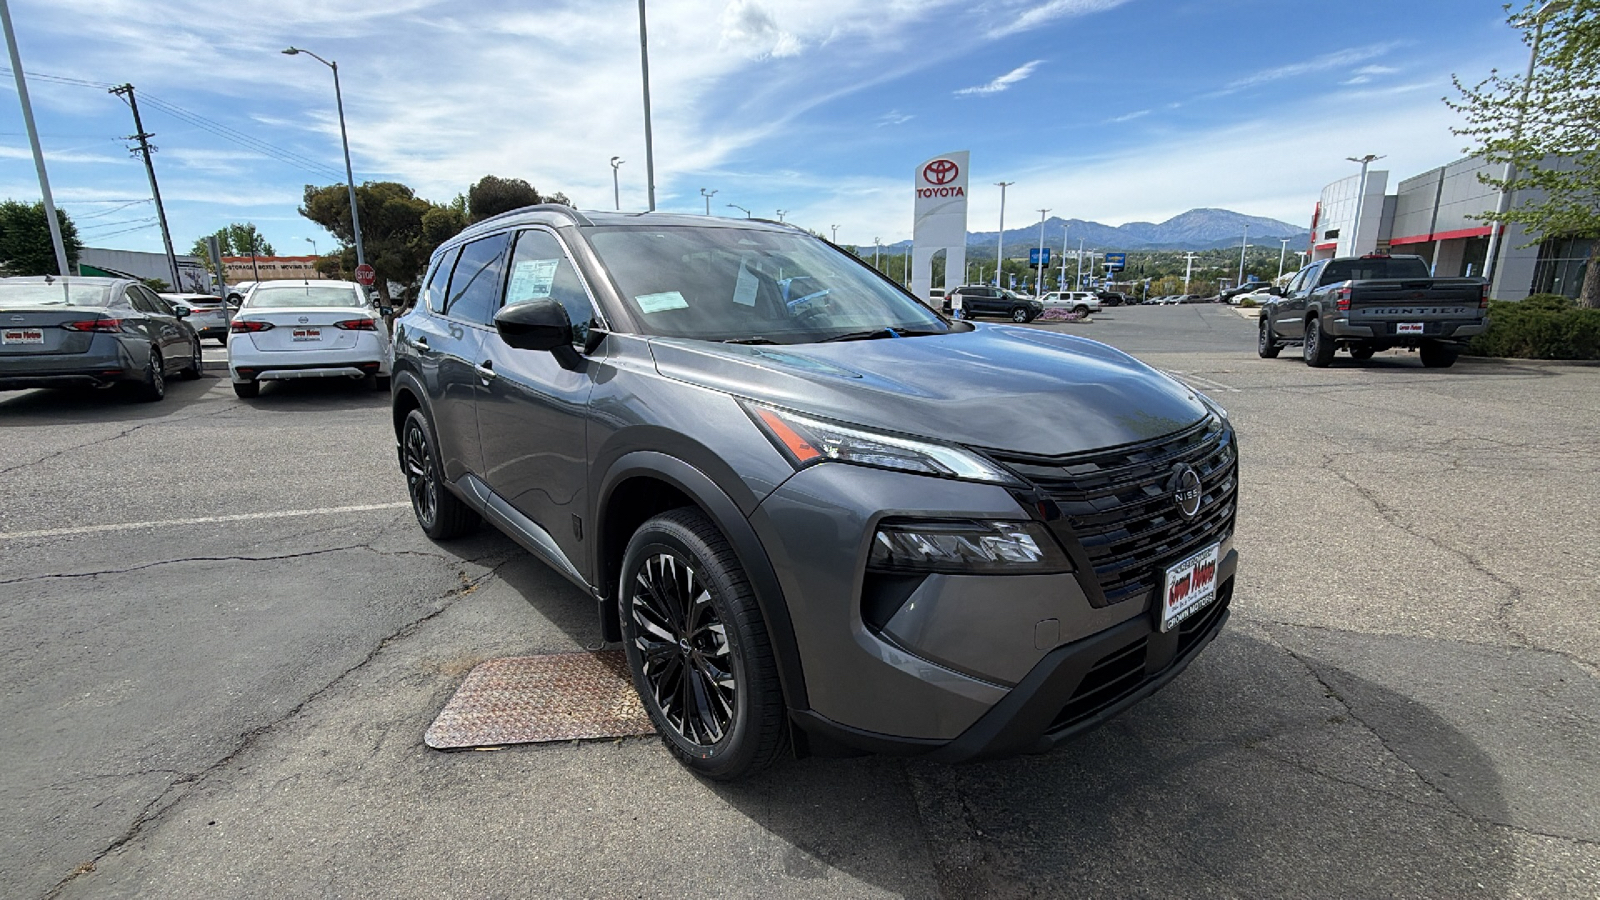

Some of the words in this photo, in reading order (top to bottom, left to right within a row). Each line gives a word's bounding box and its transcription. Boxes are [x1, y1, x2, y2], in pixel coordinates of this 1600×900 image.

[917, 186, 964, 198] TOYOTA
[357, 271, 374, 279] STOP
[1167, 609, 1189, 629] CROWN
[1189, 593, 1213, 614] MOTORS
